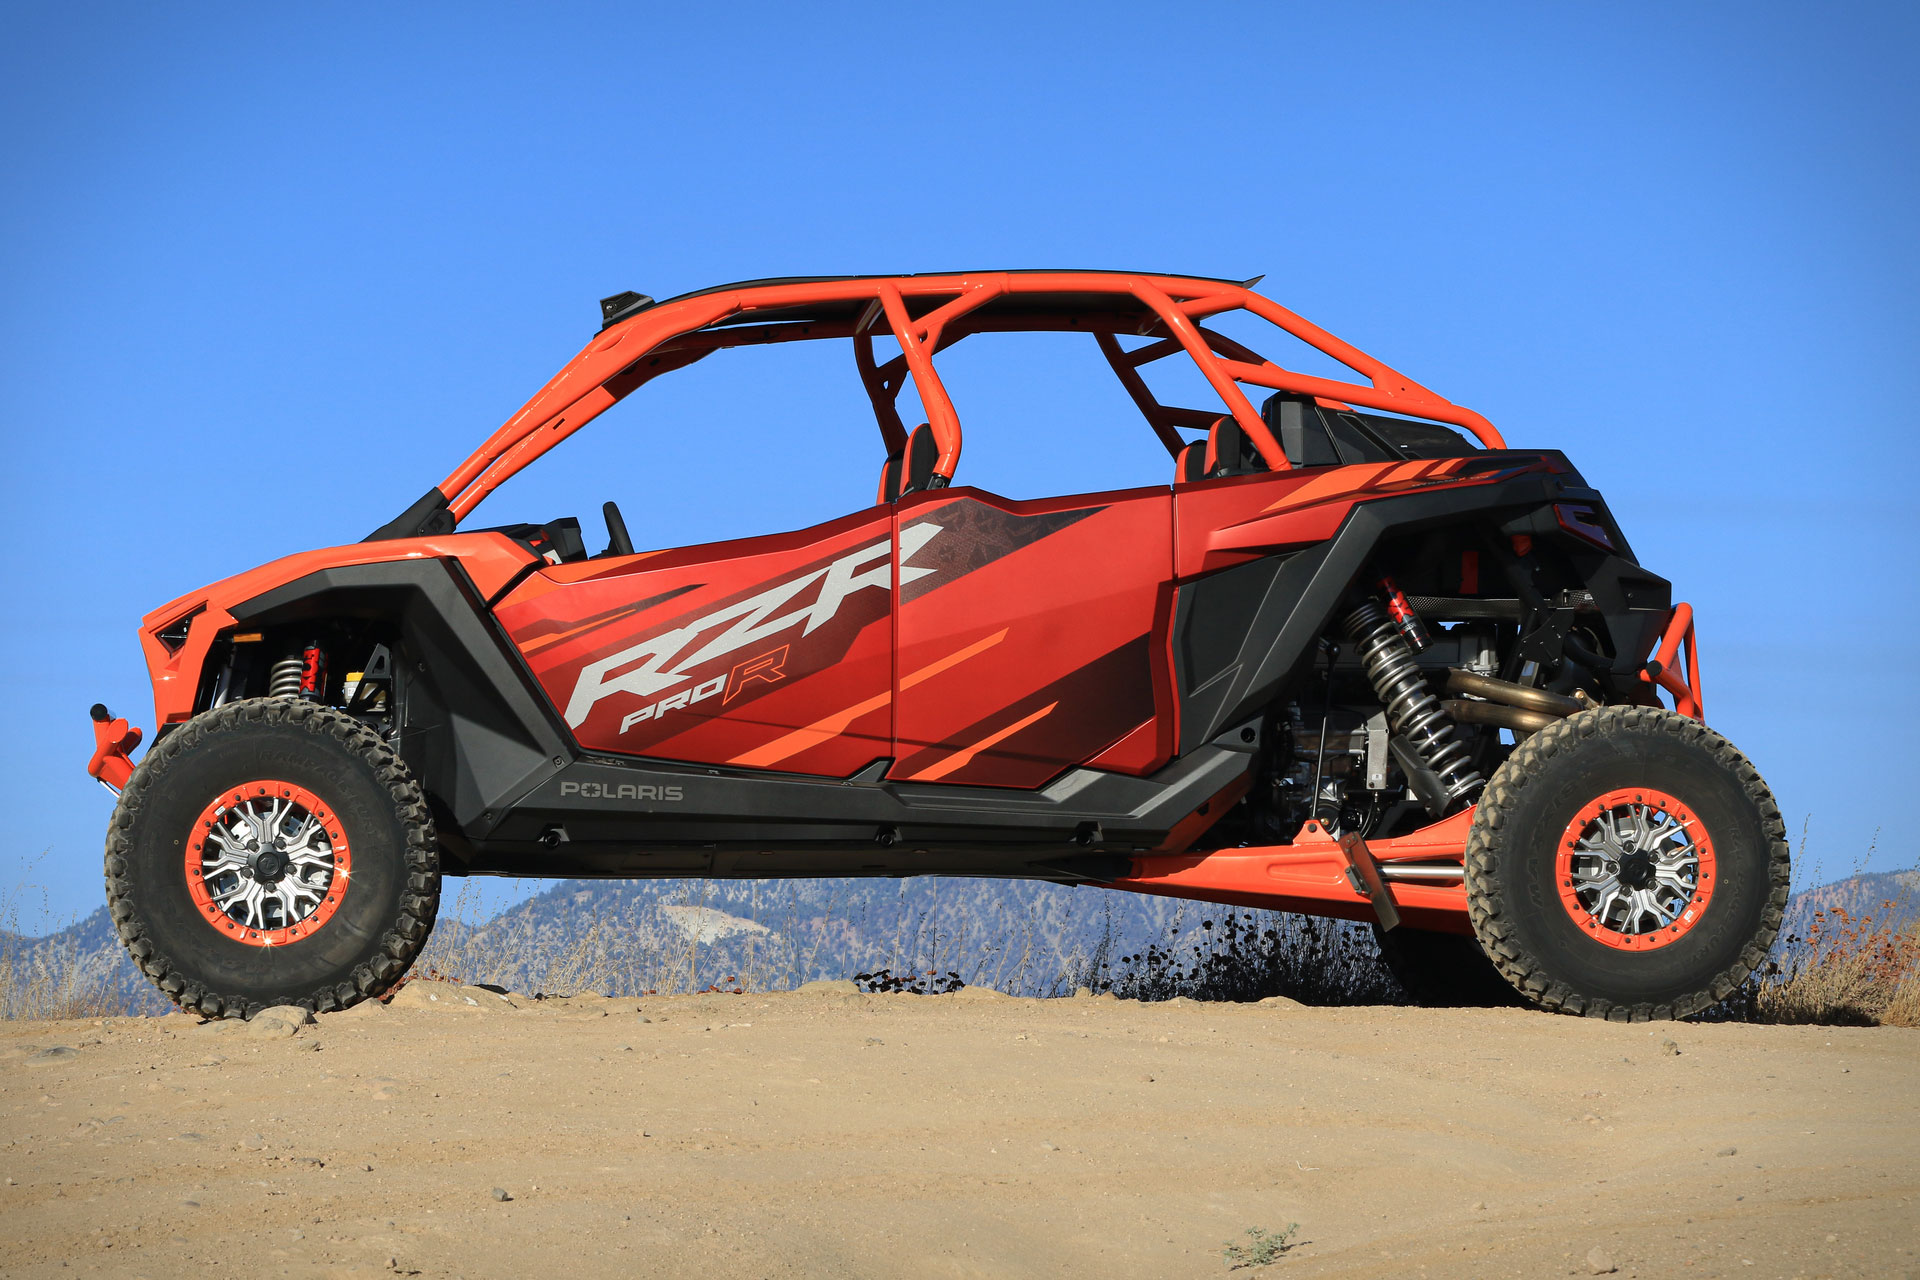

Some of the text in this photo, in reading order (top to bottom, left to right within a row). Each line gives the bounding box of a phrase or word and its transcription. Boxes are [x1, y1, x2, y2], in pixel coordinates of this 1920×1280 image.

[299, 648, 320, 692] FOX
[564, 522, 944, 730] RZR
[619, 644, 790, 735] PRO R
[560, 781, 684, 801] POLARIS
[1525, 777, 1579, 910] MAXXIS
